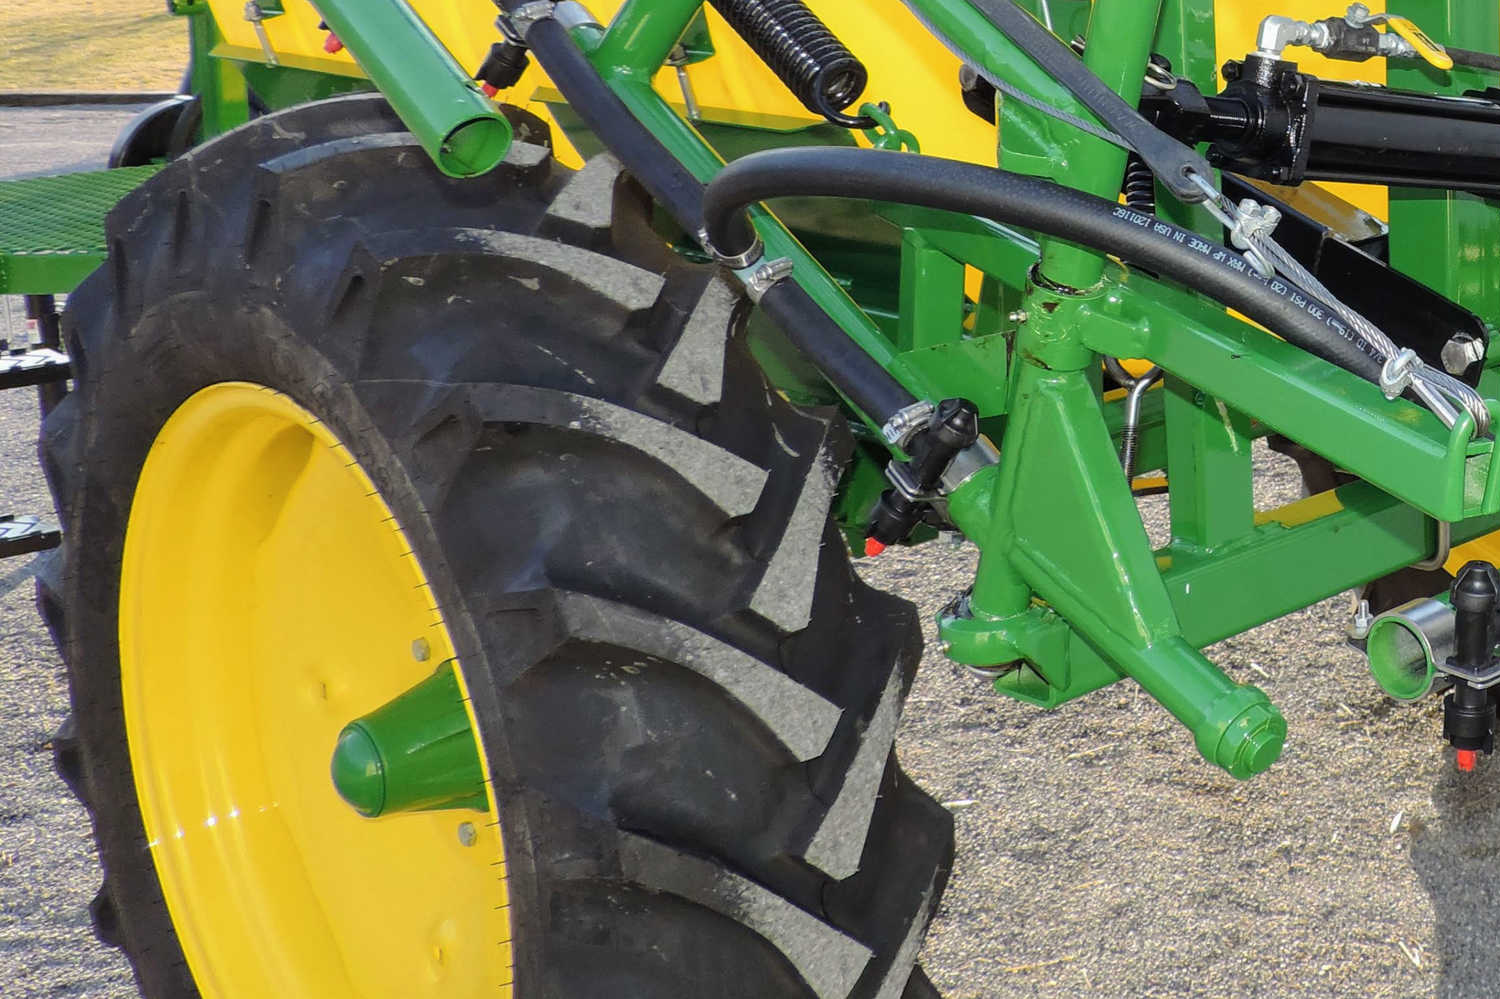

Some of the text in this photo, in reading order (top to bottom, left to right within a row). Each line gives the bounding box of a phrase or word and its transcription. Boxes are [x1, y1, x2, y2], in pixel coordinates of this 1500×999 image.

[1153, 221, 1171, 237] USA
[1172, 232, 1186, 243] IN
[1188, 238, 1212, 254] MADE
[1227, 256, 1246, 272] MAX
[1270, 281, 1287, 295] (20
[1307, 303, 1325, 320] 300
